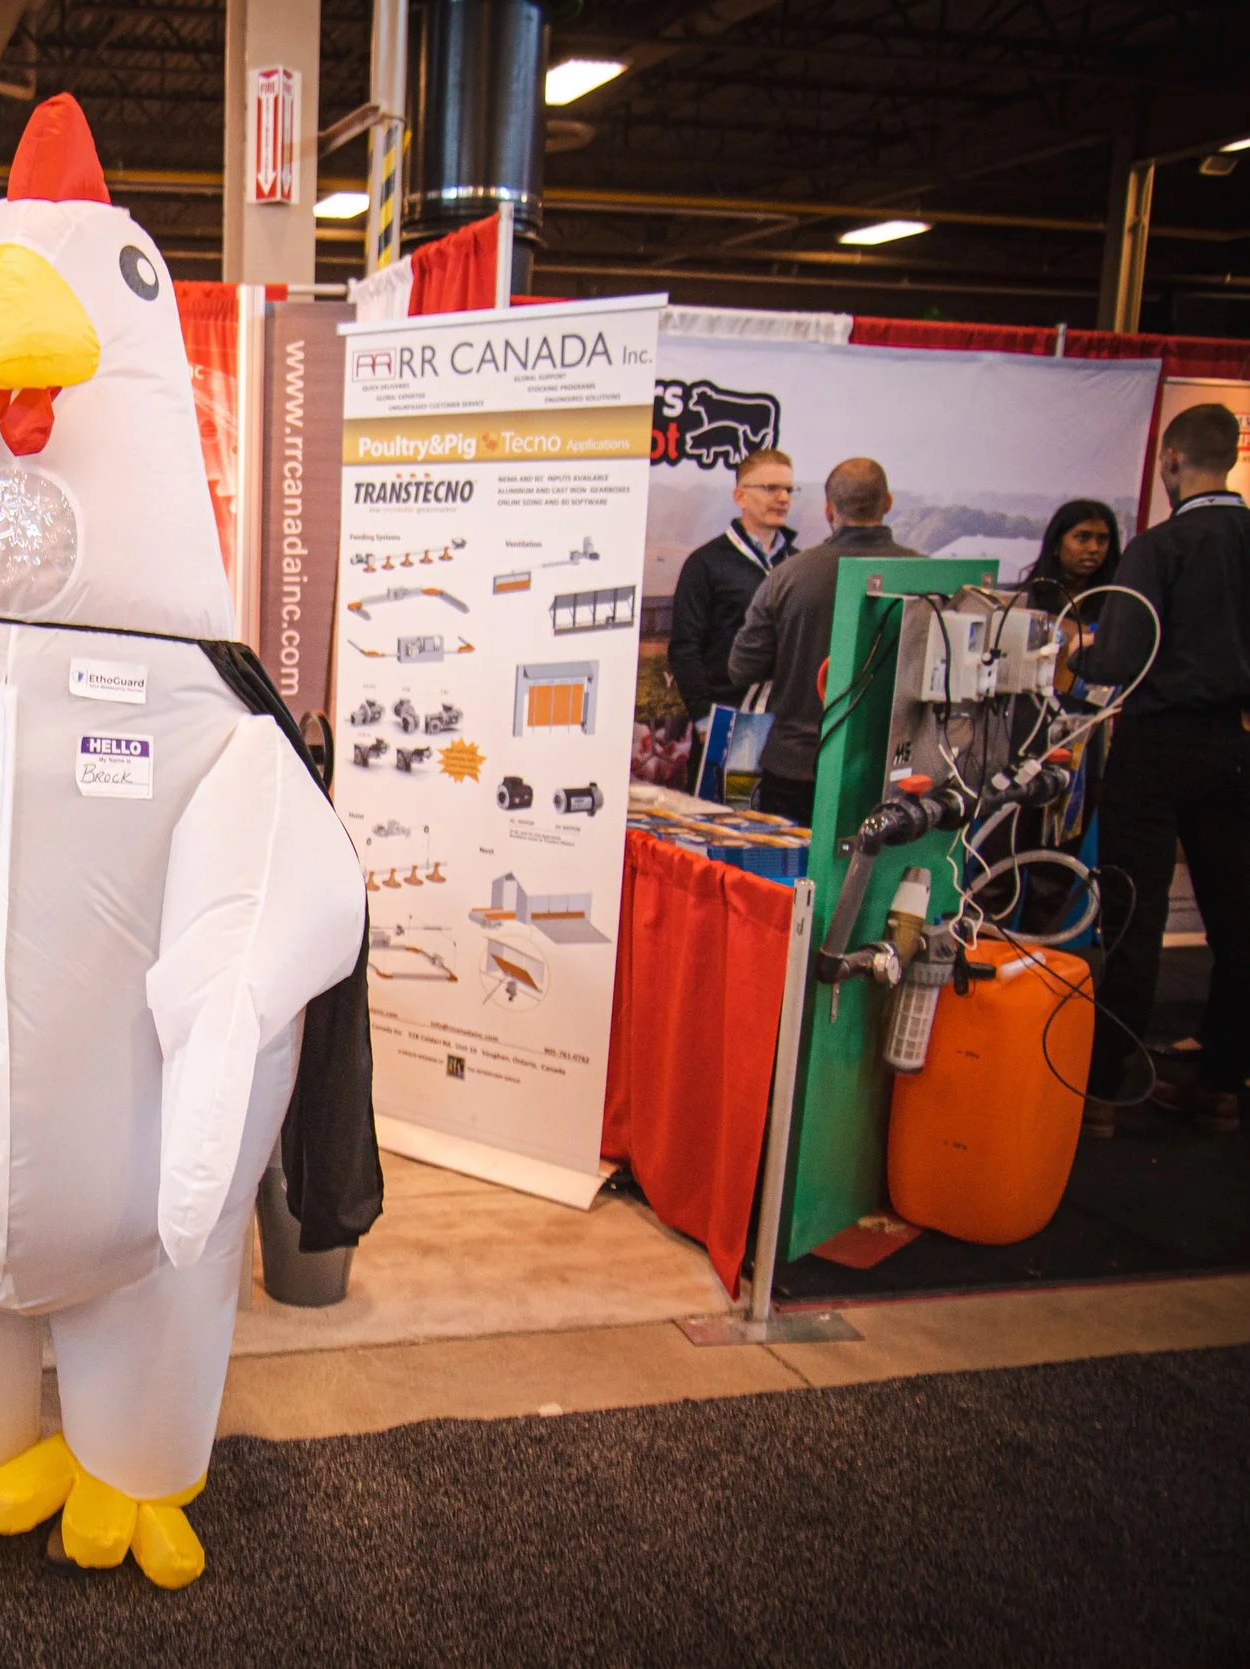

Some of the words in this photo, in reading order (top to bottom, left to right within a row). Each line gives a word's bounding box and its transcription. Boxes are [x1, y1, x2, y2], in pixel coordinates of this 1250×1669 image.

[399, 345, 439, 379] RR
[450, 332, 612, 375] CANADA
[622, 346, 653, 366] Inc.
[358, 432, 477, 462] Poultry&Pig
[501, 431, 562, 453] Tecno
[566, 439, 630, 453] Applications
[354, 480, 474, 504] TRANSTECNO
[280, 340, 308, 697] www.rrcanadainc.com
[505, 540, 542, 548] Ventilation
[89, 674, 145, 688] EthoGuard
[89, 738, 142, 756] HELLO
